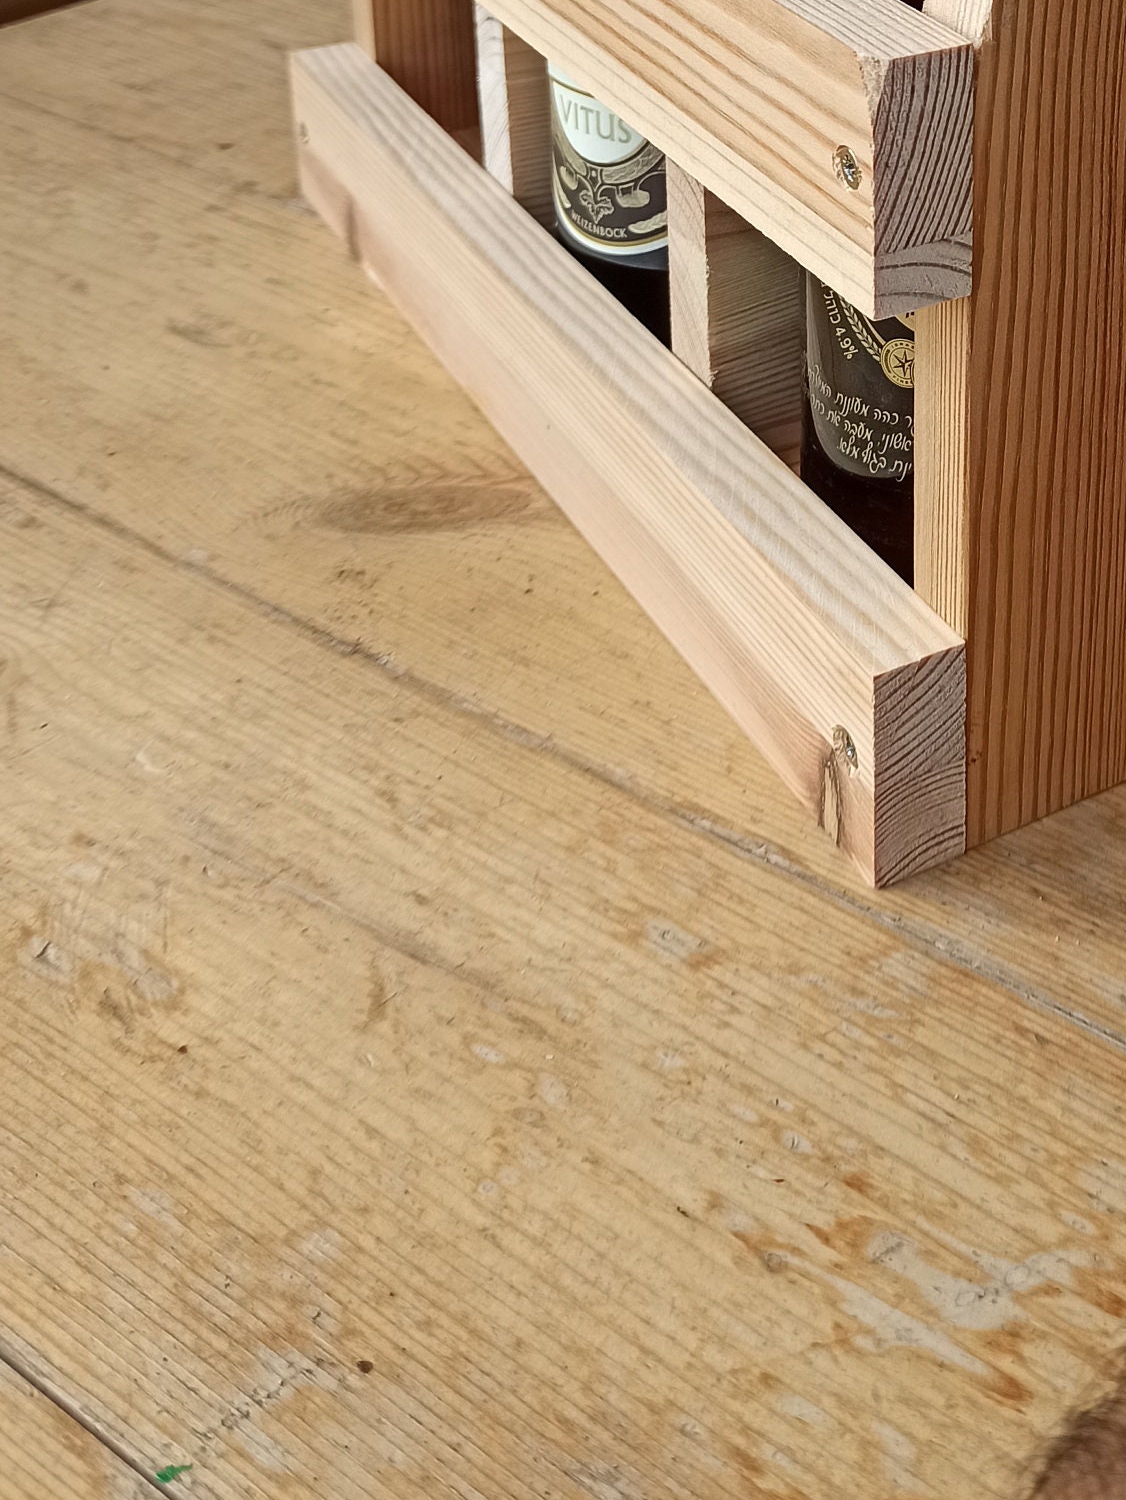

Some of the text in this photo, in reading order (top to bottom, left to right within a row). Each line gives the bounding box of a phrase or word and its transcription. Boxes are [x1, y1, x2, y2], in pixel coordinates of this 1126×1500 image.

[559, 93, 632, 144] VITUS
[571, 208, 628, 238] WEIZENBOCK
[835, 327, 859, 360] 4.9%
